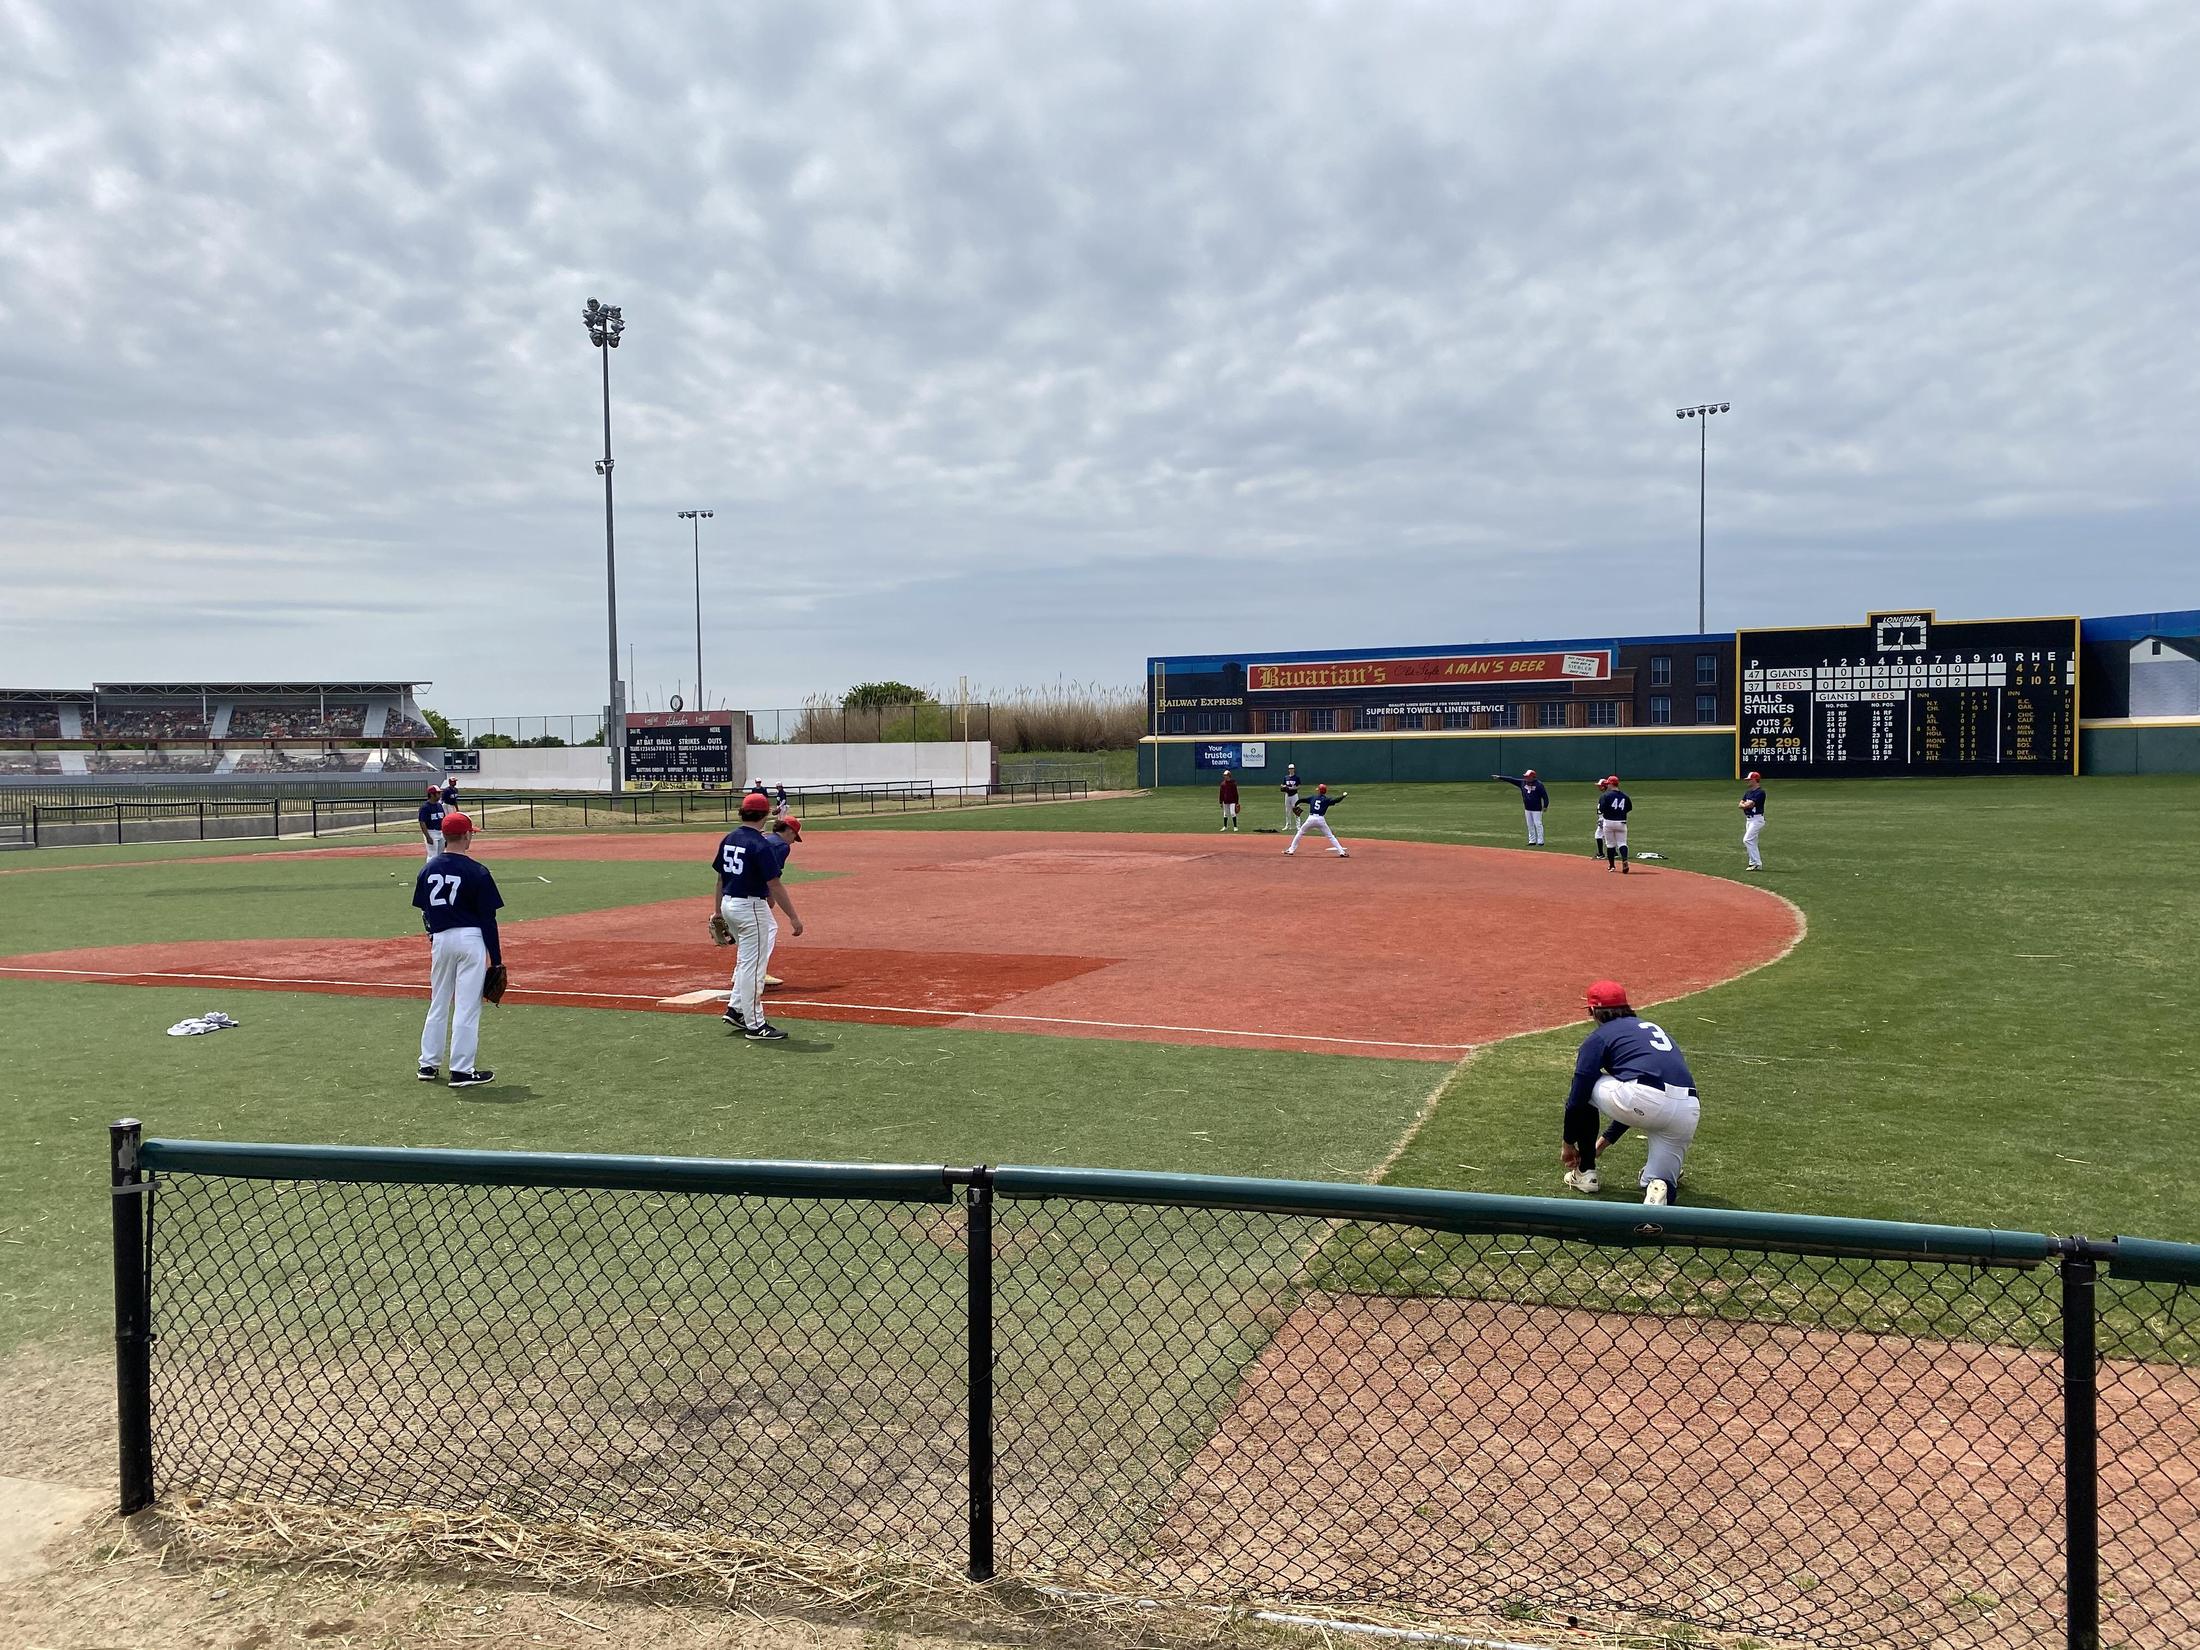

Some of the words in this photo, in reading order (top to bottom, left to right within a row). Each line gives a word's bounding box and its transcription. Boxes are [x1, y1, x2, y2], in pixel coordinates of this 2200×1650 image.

[1752, 660, 1758, 669] P
[1878, 657, 1885, 665] 4
[1916, 656, 1922, 664] 6
[1955, 655, 1961, 663] 8
[1974, 654, 1980, 662] 9
[1991, 654, 2003, 662] 10
[2016, 653, 2024, 661] R
[2032, 652, 2040, 661] H
[2048, 652, 2055, 660] E
[1445, 664, 1453, 674] A
[1456, 661, 1504, 674] MAN'S
[1510, 661, 1545, 672] BEER
[1770, 669, 1808, 678] GIANTS
[2016, 664, 2023, 672] 4
[1258, 664, 1386, 688] Bavarian's
[2032, 676, 2041, 684] 10
[2049, 676, 2056, 684] 2
[1745, 694, 1782, 704] BALLS
[1744, 704, 1794, 714] STRIKES
[1784, 718, 1791, 726] 2
[1751, 738, 1767, 747] 25
[1776, 738, 1800, 747] 299
[1315, 800, 1321, 810] 5
[1611, 798, 1625, 810] 44
[723, 844, 746, 875] 55
[428, 874, 462, 906] 27
[1638, 1022, 1673, 1052] 3
